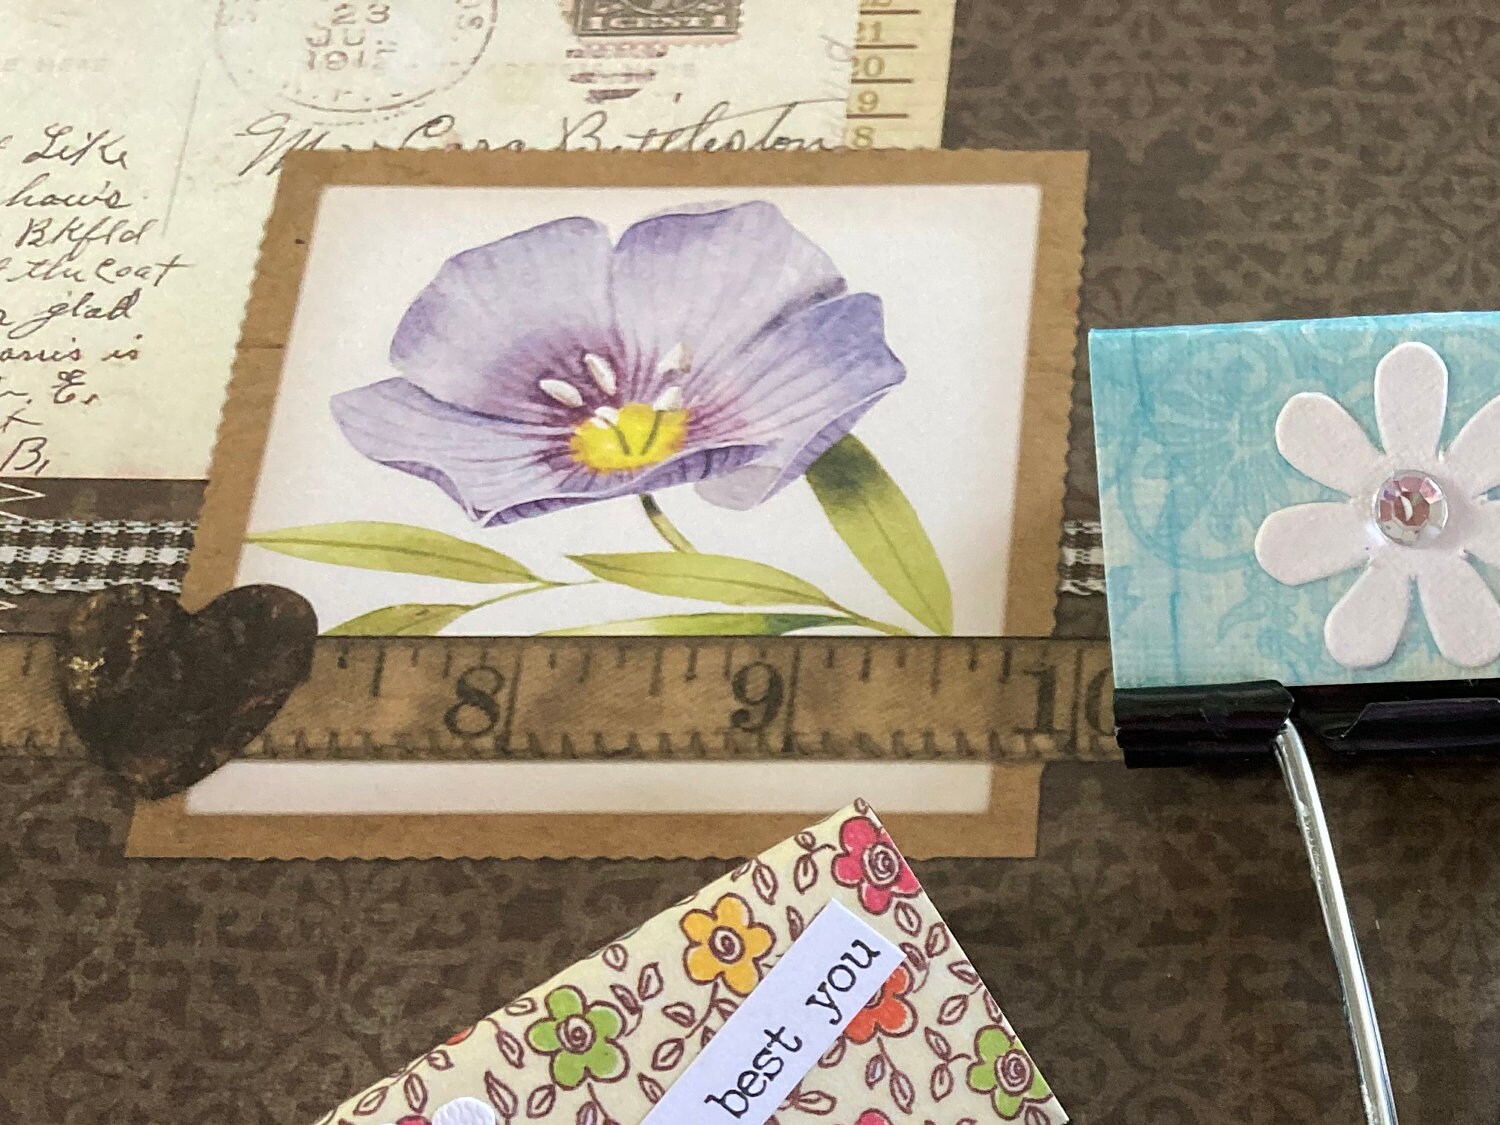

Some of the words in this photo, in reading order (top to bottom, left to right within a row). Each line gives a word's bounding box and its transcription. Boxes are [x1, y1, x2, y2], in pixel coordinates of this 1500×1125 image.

[331, 2, 391, 26] 23
[444, 666, 504, 737] 8
[731, 661, 783, 733] 9
[704, 1025, 803, 1119] best
[805, 938, 881, 1025] you
